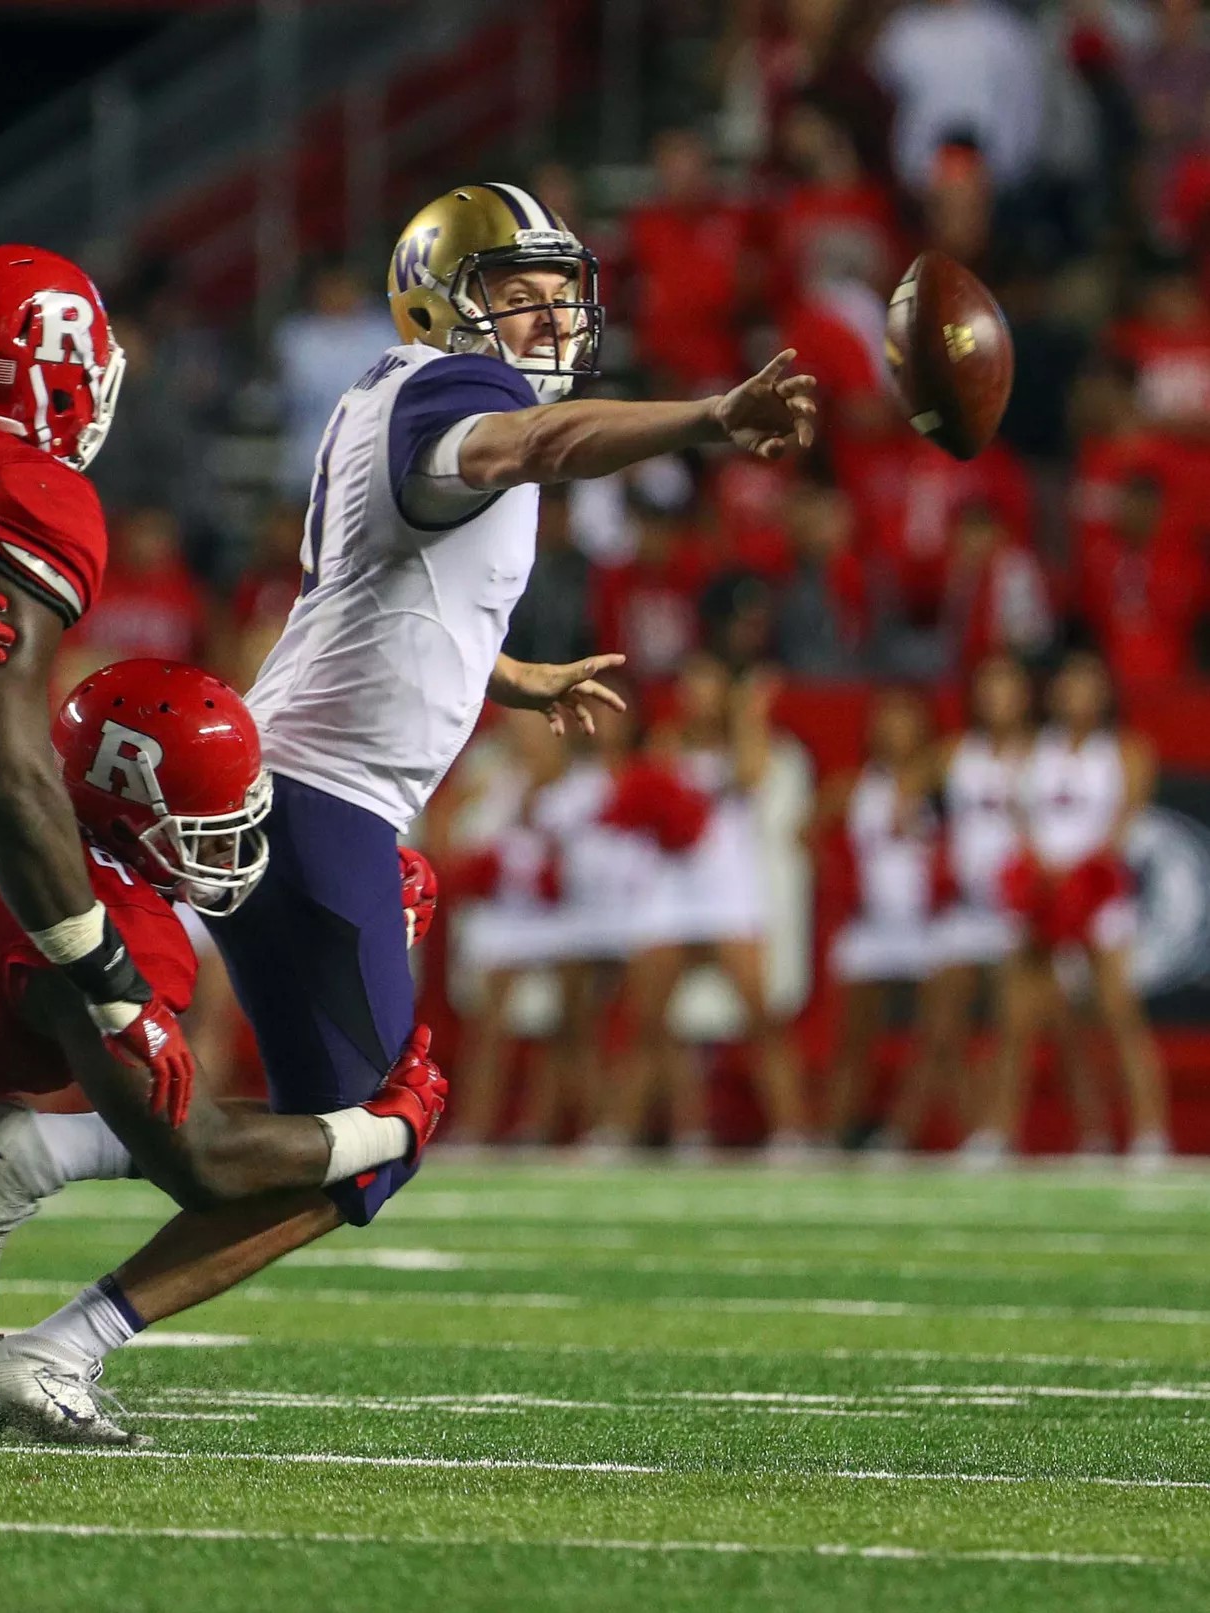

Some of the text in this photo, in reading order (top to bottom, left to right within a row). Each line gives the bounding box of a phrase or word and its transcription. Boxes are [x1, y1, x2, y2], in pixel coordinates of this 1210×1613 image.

[394, 228, 439, 293] W
[32, 290, 94, 365] R
[84, 718, 164, 806] R
